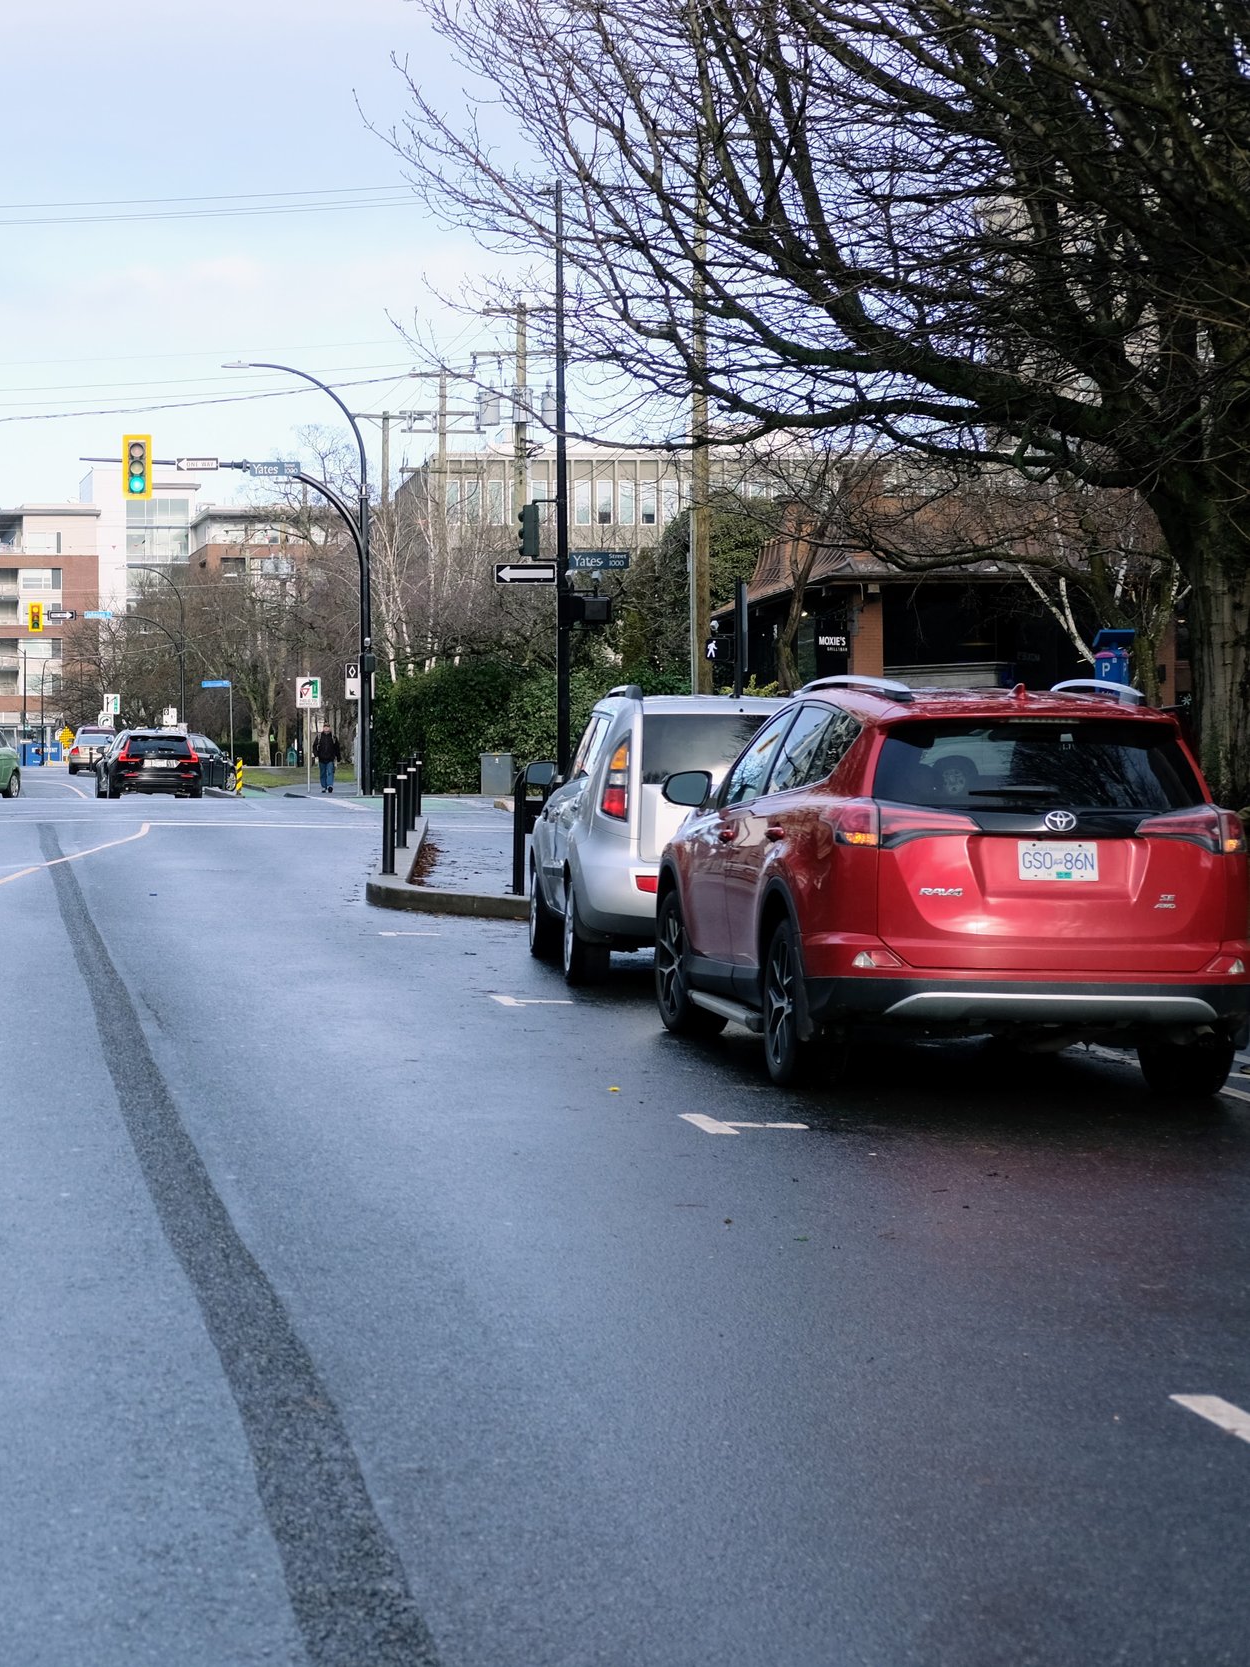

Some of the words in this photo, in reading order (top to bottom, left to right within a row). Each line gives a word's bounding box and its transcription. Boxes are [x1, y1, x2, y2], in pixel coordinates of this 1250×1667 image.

[252, 463, 279, 475] Yates
[573, 554, 604, 567] Yates
[608, 559, 625, 567] 1000
[818, 636, 847, 646] MOXIE'S
[1101, 662, 1111, 677] P
[1063, 852, 1095, 871] 86N
[919, 887, 963, 897] RAV4
